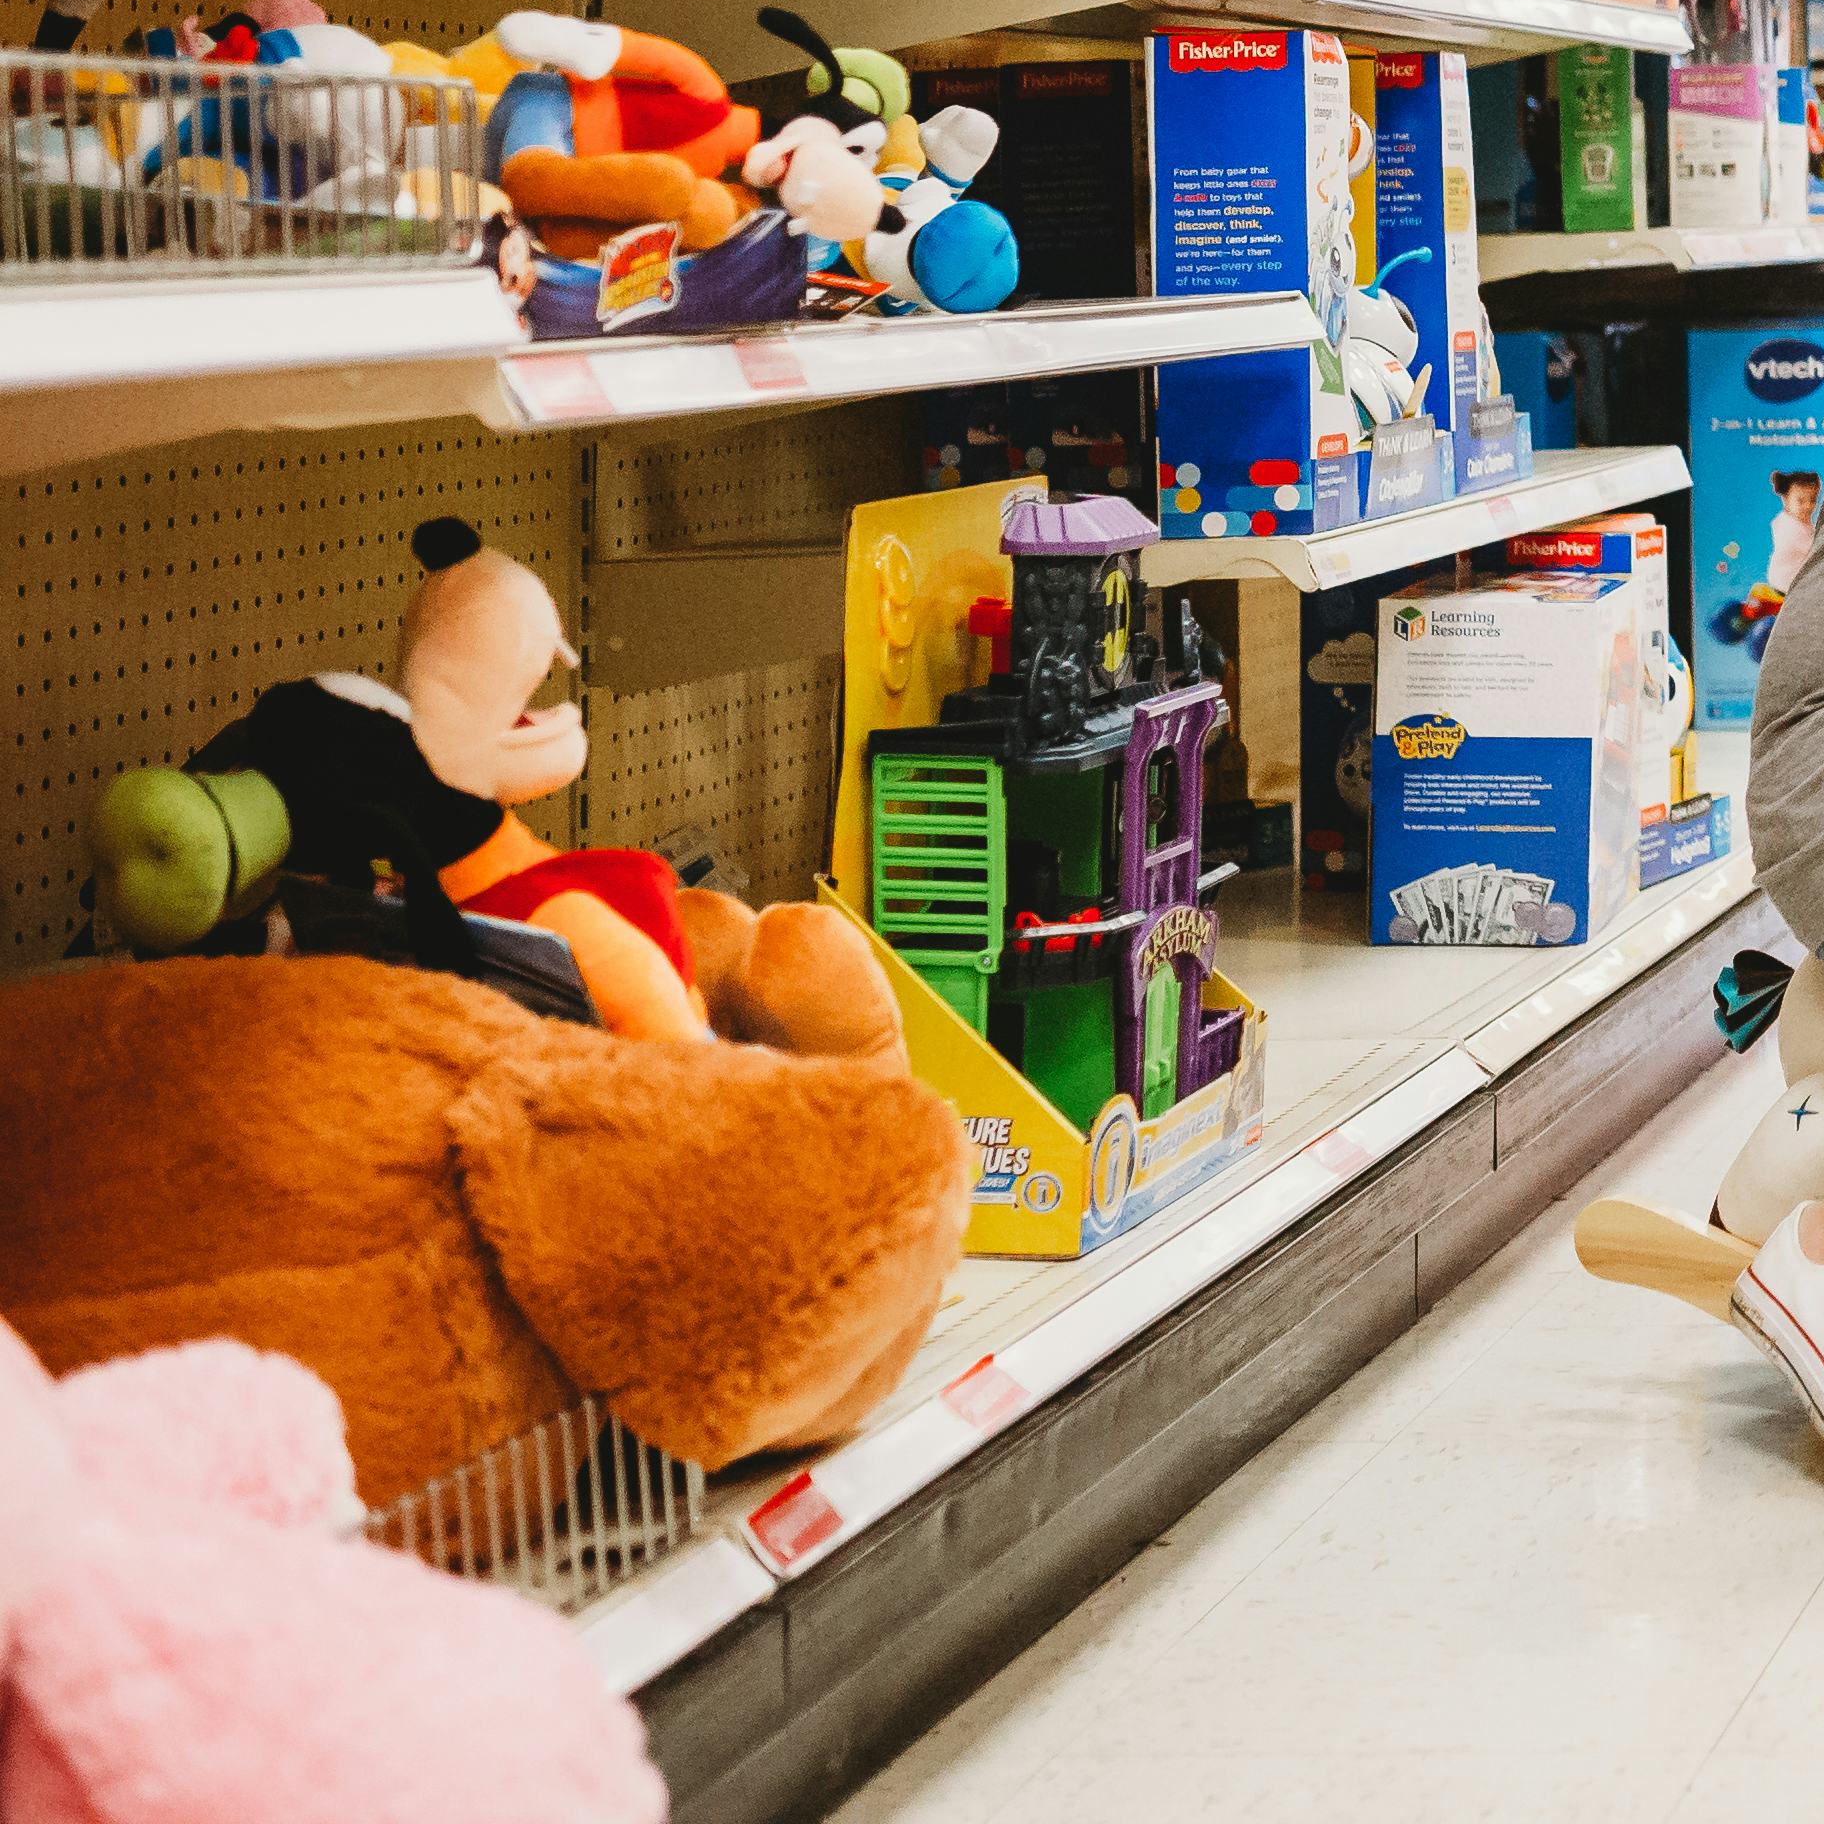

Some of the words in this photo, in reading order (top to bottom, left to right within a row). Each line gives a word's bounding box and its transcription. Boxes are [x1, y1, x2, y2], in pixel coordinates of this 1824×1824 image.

[1178, 41, 1280, 60] Fisher-Price
[1173, 168, 1198, 176] From
[1201, 167, 1224, 176] baby
[1226, 168, 1248, 176] gear
[1250, 166, 1269, 174] that
[1173, 181, 1201, 190] keeps
[1203, 180, 1224, 188] little
[1222, 193, 1242, 202] toys
[1244, 192, 1263, 201] that
[1174, 208, 1195, 217] help
[1197, 208, 1221, 216] them
[1223, 205, 1274, 216] develop,
[1174, 220, 1227, 232] discover,
[1229, 219, 1263, 230] think,
[1225, 235, 1248, 245] (and
[1247, 248, 1272, 256] them
[1175, 264, 1193, 272] and
[1257, 260, 1283, 271] step
[1175, 276, 1188, 286] of
[1192, 277, 1211, 286] the
[1215, 277, 1240, 287] way.
[1758, 418, 1802, 430] Learn
[1805, 417, 1817, 430] &
[1513, 540, 1595, 558] Fisher-Price
[1431, 610, 1495, 625] Learning
[1431, 625, 1501, 638] Resources
[1395, 724, 1462, 742] Pretend
[1401, 741, 1414, 756] &
[1417, 740, 1455, 756] Play
[1142, 907, 1211, 977] ARKHAM
[1153, 934, 1202, 972] ASYLUM
